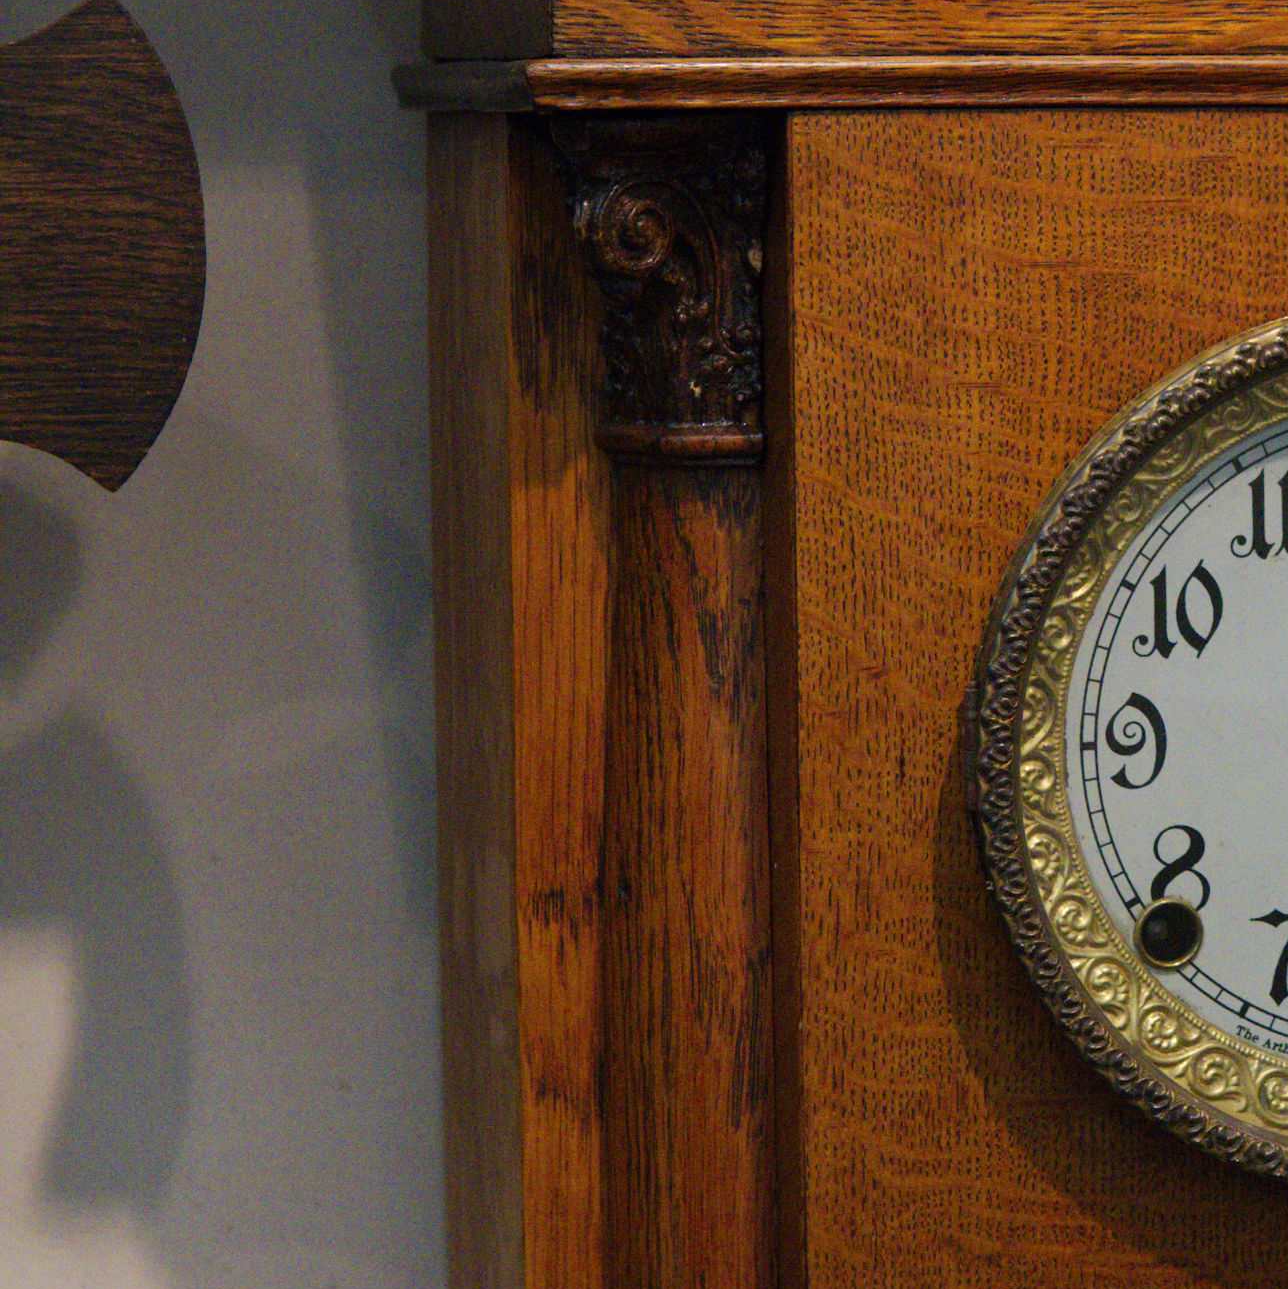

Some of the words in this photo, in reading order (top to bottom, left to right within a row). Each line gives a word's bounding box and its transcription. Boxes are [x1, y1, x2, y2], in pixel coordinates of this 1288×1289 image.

[1131, 557, 1224, 659] 10
[1104, 691, 1168, 791] 9
[1150, 823, 1211, 912] 8
[1235, 1024, 1260, 1044] The
